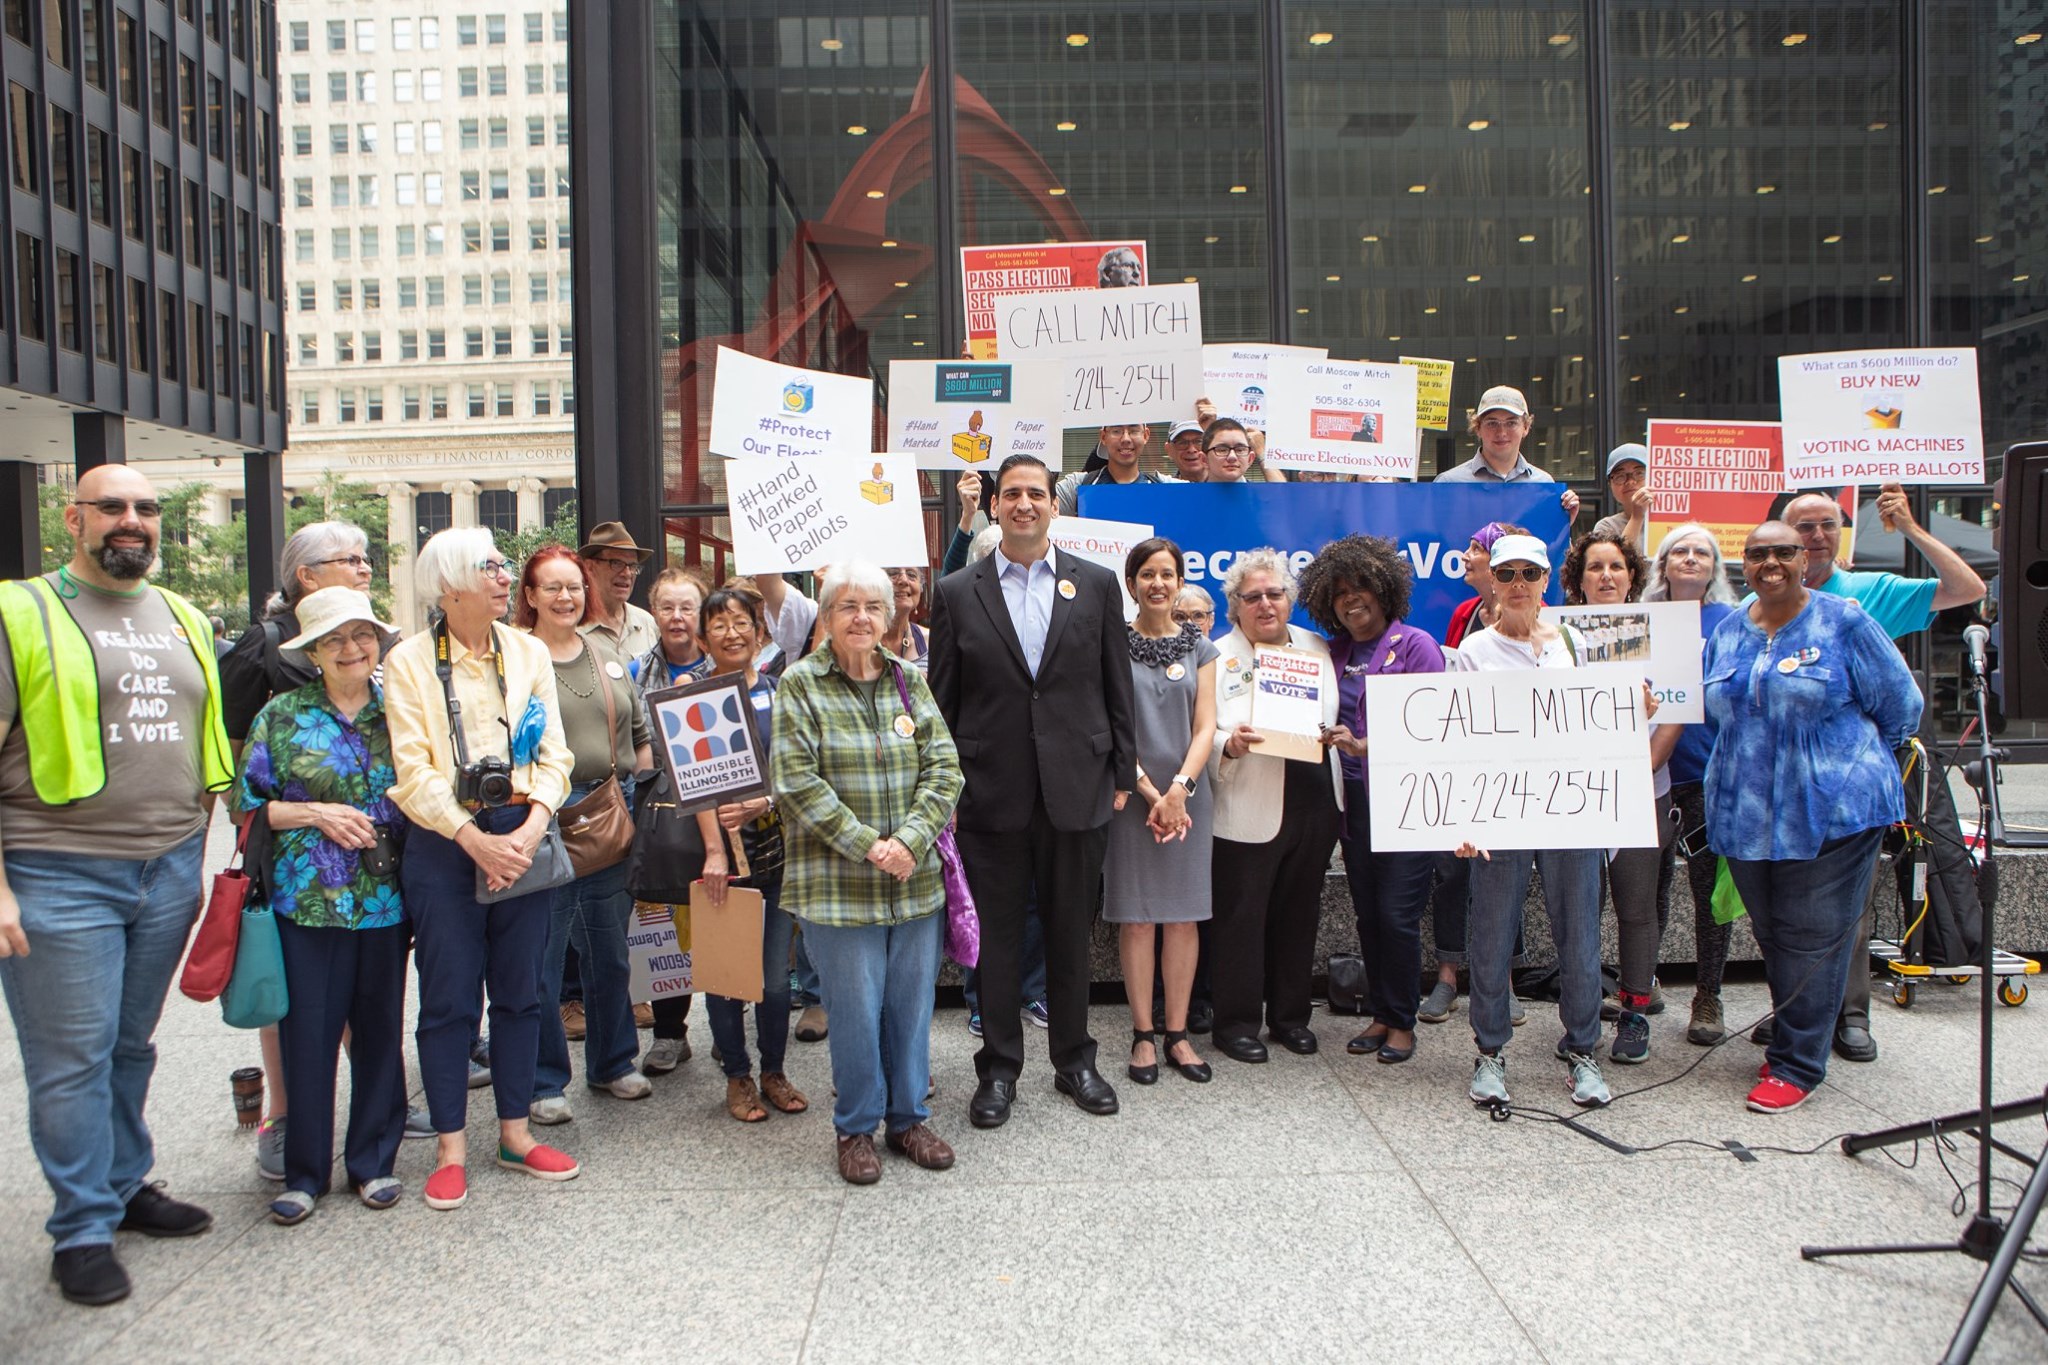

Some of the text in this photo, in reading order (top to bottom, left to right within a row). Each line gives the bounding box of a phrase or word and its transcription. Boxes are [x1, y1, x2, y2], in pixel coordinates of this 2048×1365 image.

[997, 251, 1021, 259] Moscow
[969, 268, 1069, 289] PASS ELECTION
[1008, 301, 1189, 349] CALL MITCH
[1232, 352, 1260, 360] Moscow
[1803, 356, 1958, 371] What can $600 Million do?
[1307, 365, 1390, 379] Call Moscow Mitch
[1841, 374, 1921, 389] BUY NEW
[945, 379, 1002, 391] $600 MILLION
[1063, 363, 1175, 412] -224-2541
[1315, 395, 1381, 407] 505-582-6304
[759, 417, 832, 441] #Protect
[905, 421, 1044, 433] #Hand Paper
[743, 437, 771, 455] Our
[902, 438, 1045, 450] Marked Ballots
[1804, 438, 1965, 454] VOTING MACHINES
[348, 448, 573, 465] WINTRUST FINANCIAL CORPO
[1267, 448, 1413, 468] #Secure Elections NOW
[1654, 448, 1767, 468] PASS ELECTION
[1790, 462, 1980, 480] WITH PAPER BALLOTS
[737, 460, 800, 512] #Hand
[1654, 471, 1785, 492] SECURITY FUNDIN
[747, 474, 818, 532] Marked
[1653, 494, 1688, 512] NOW
[768, 497, 825, 543] Paper
[784, 515, 848, 565] Ballots
[122, 617, 135, 631] I
[95, 630, 171, 650] REALLY
[438, 637, 447, 661] Nikon
[129, 651, 157, 670] DO
[118, 672, 176, 695] CARE.
[1281, 672, 1297, 684] to
[1270, 683, 1308, 699] VOTE
[1654, 688, 1686, 704] ote
[128, 697, 168, 718] AND
[1403, 686, 1635, 742] CALL MITCH
[109, 721, 184, 743] I VOTE.
[678, 755, 753, 780] INDIVISIBLE
[680, 767, 754, 792] ILLINOIS 9TH
[1398, 769, 1618, 830] 202-224-2541
